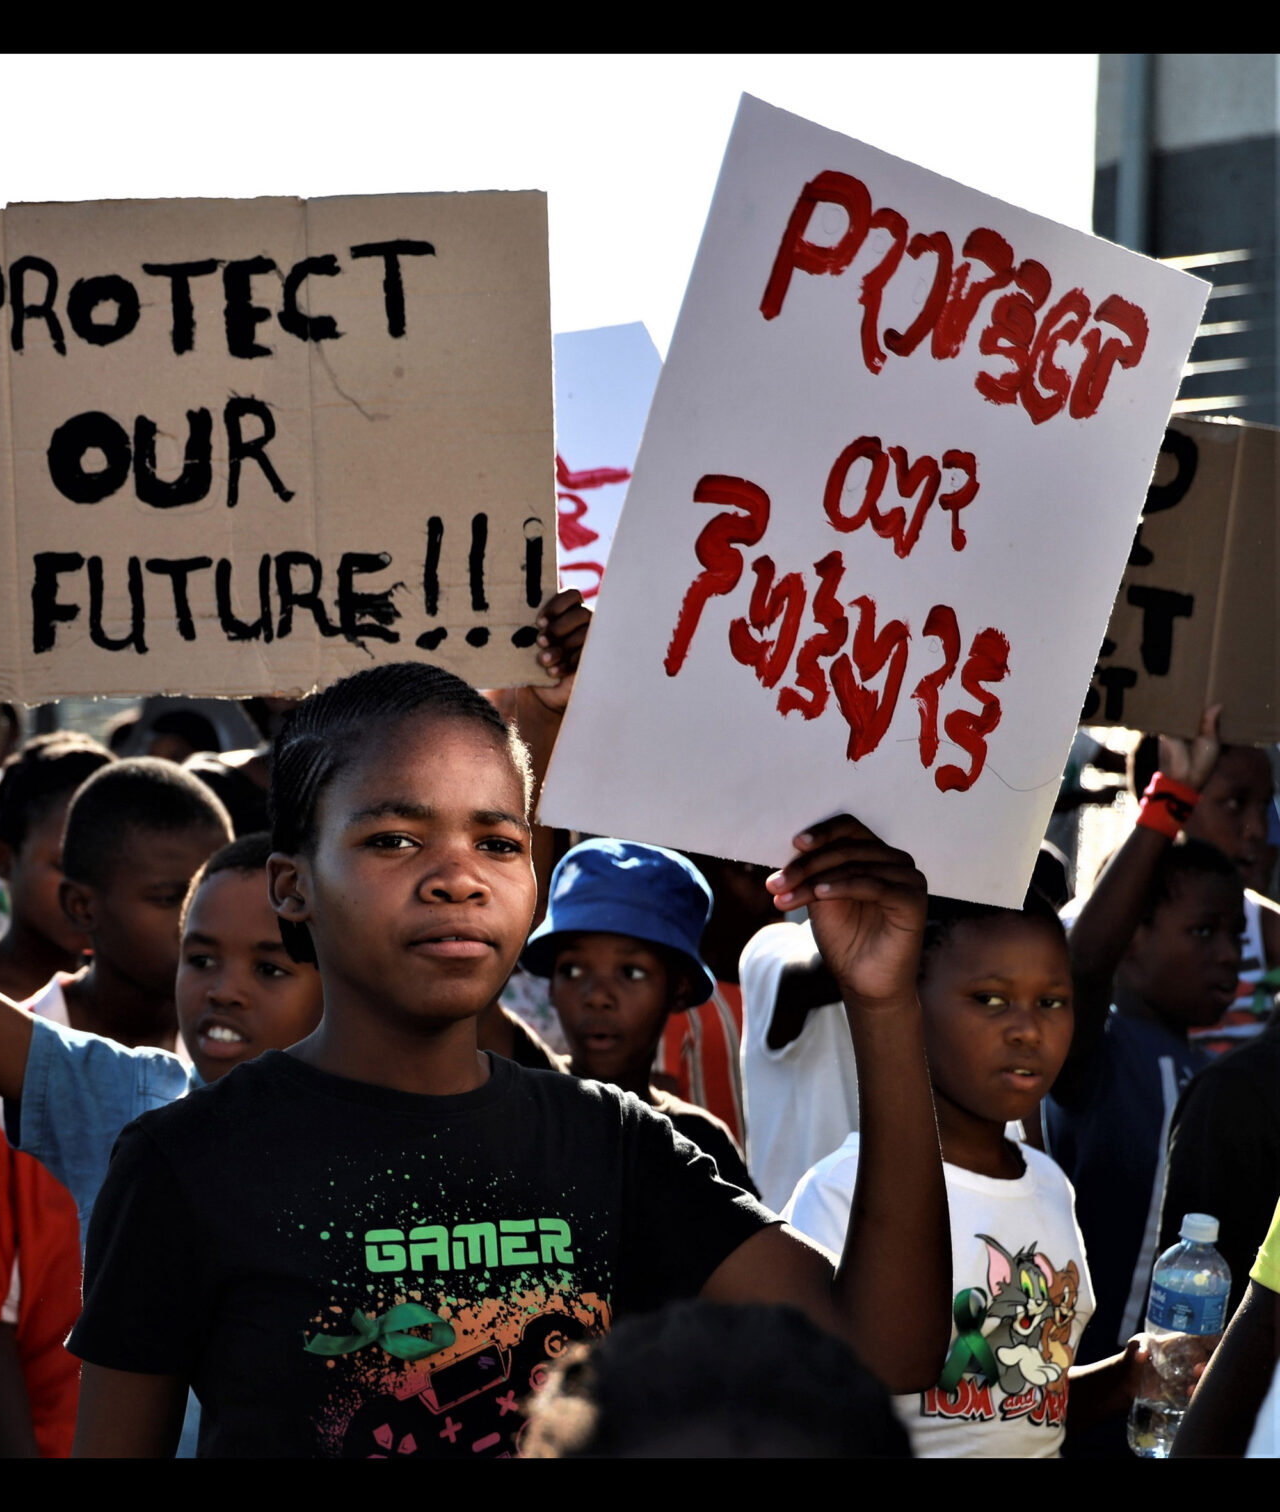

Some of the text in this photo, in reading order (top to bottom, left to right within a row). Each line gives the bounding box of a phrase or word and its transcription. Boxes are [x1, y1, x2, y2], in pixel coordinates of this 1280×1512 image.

[47, 395, 295, 508] OUR
[32, 512, 542, 655] FUTURE!!!
[365, 1218, 574, 1273] GAMER
